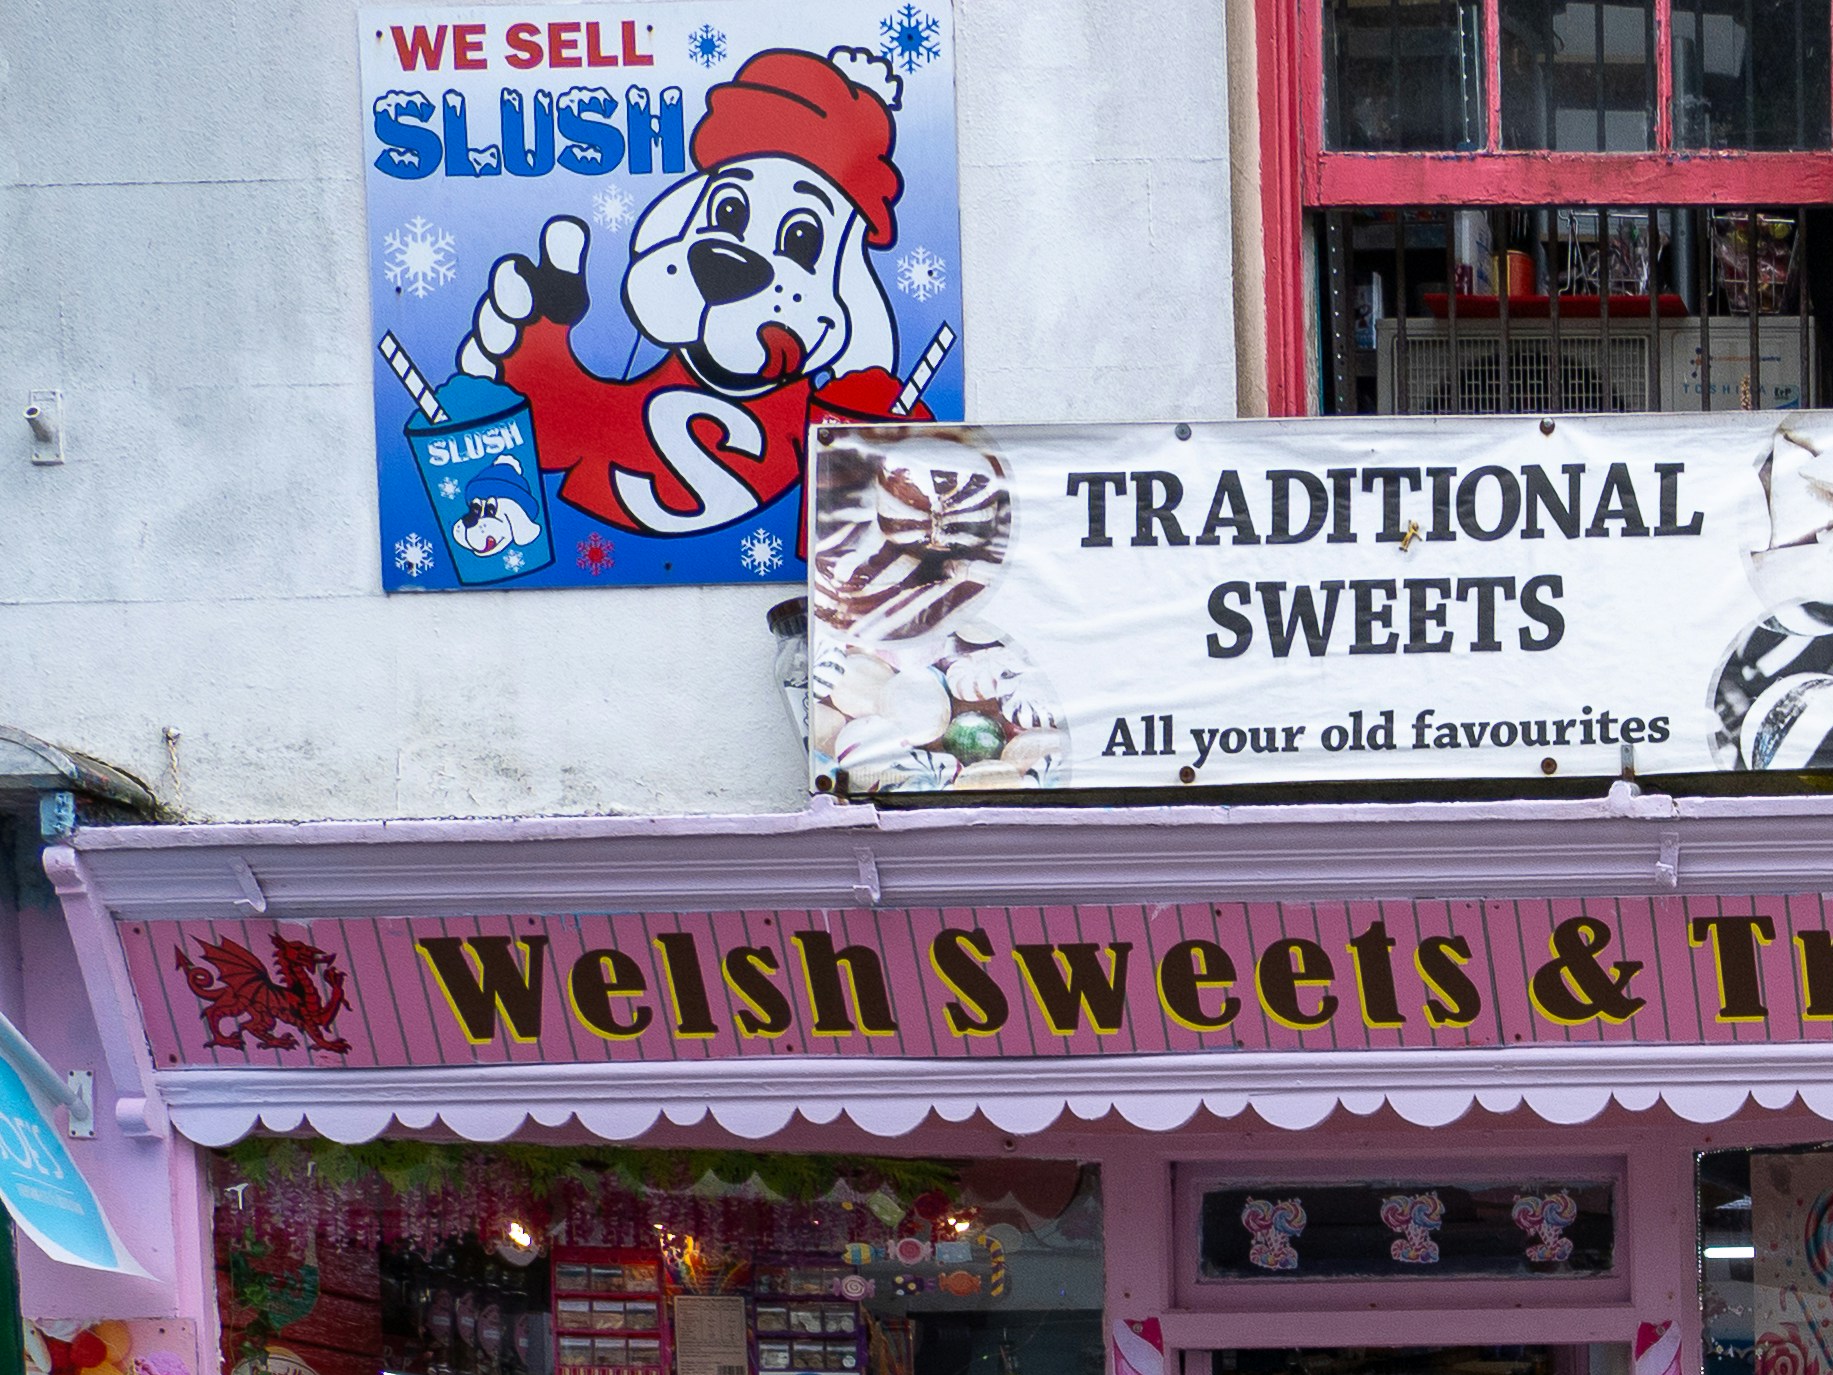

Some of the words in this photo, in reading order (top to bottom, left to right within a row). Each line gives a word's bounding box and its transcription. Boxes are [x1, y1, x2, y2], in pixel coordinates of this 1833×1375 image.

[390, 23, 487, 71] WE
[504, 20, 654, 68] SELL
[373, 84, 686, 180] SLUSH
[1683, 384, 1766, 396] TOSHIA
[427, 421, 524, 468] SLUSH
[1066, 462, 1704, 550] TRADITIONAL
[1206, 575, 1565, 660] SWEETS
[1102, 714, 1174, 758] All
[1190, 717, 1307, 768] your
[1321, 710, 1395, 754] old
[1412, 706, 1670, 749] favourites
[416, 932, 899, 1047] Welsh
[929, 920, 1482, 1038] Sweets
[1528, 916, 1646, 1027] &
